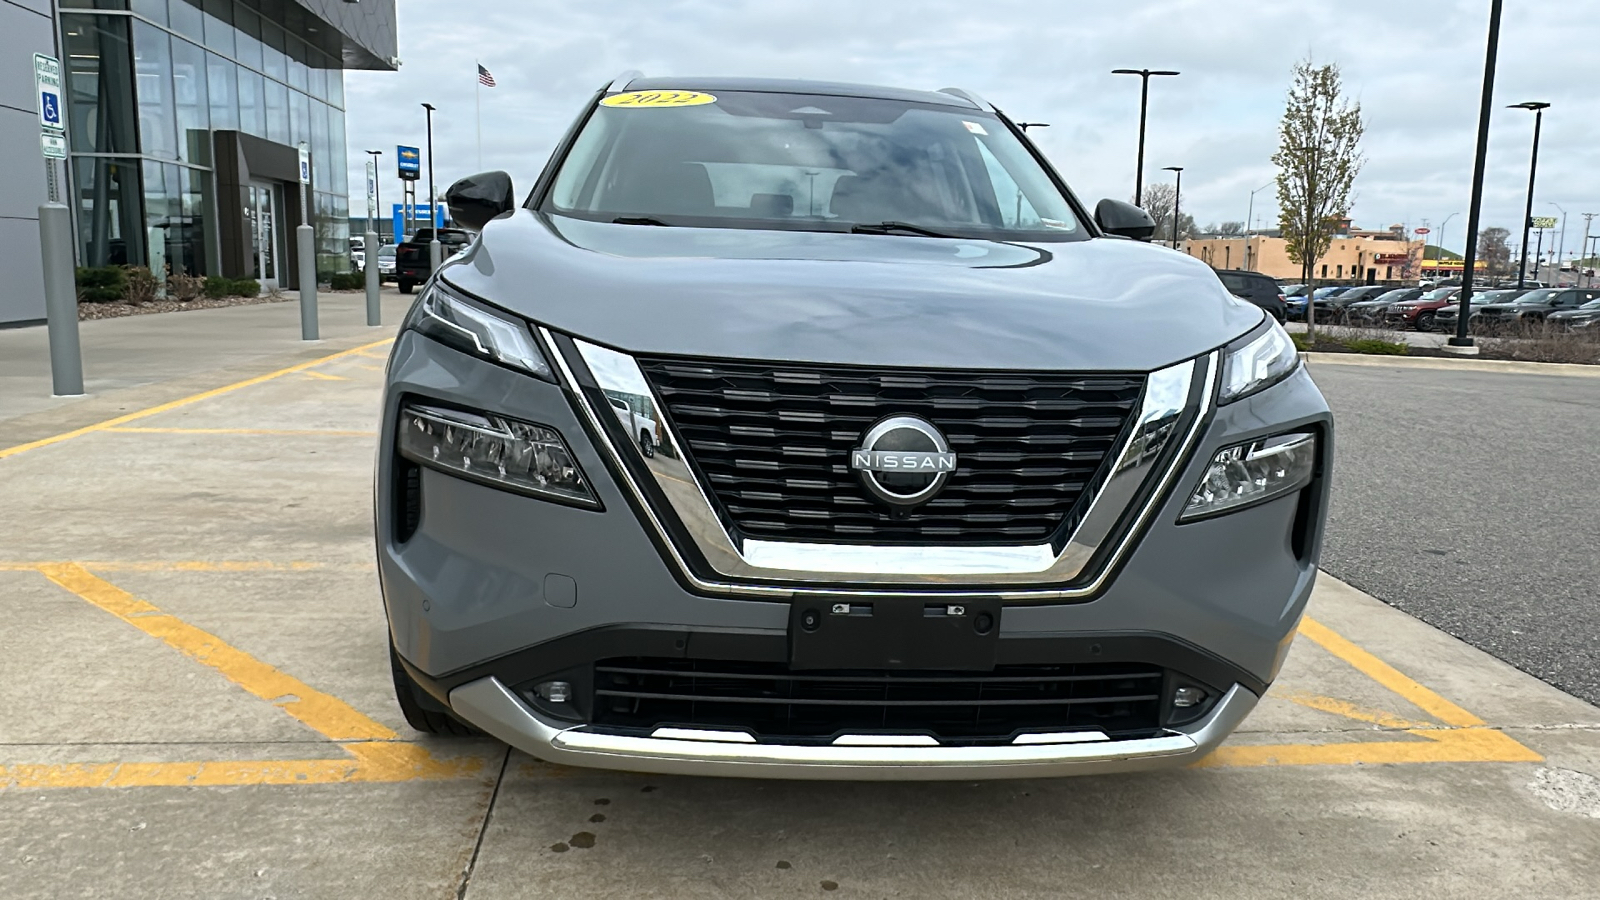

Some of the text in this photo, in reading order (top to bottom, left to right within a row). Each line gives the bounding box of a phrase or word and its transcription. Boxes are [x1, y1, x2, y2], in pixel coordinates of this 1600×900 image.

[37, 62, 58, 75] RESERVED
[38, 74, 59, 87] PARKING
[619, 93, 698, 104] 2022
[856, 454, 953, 468] NISSAN
